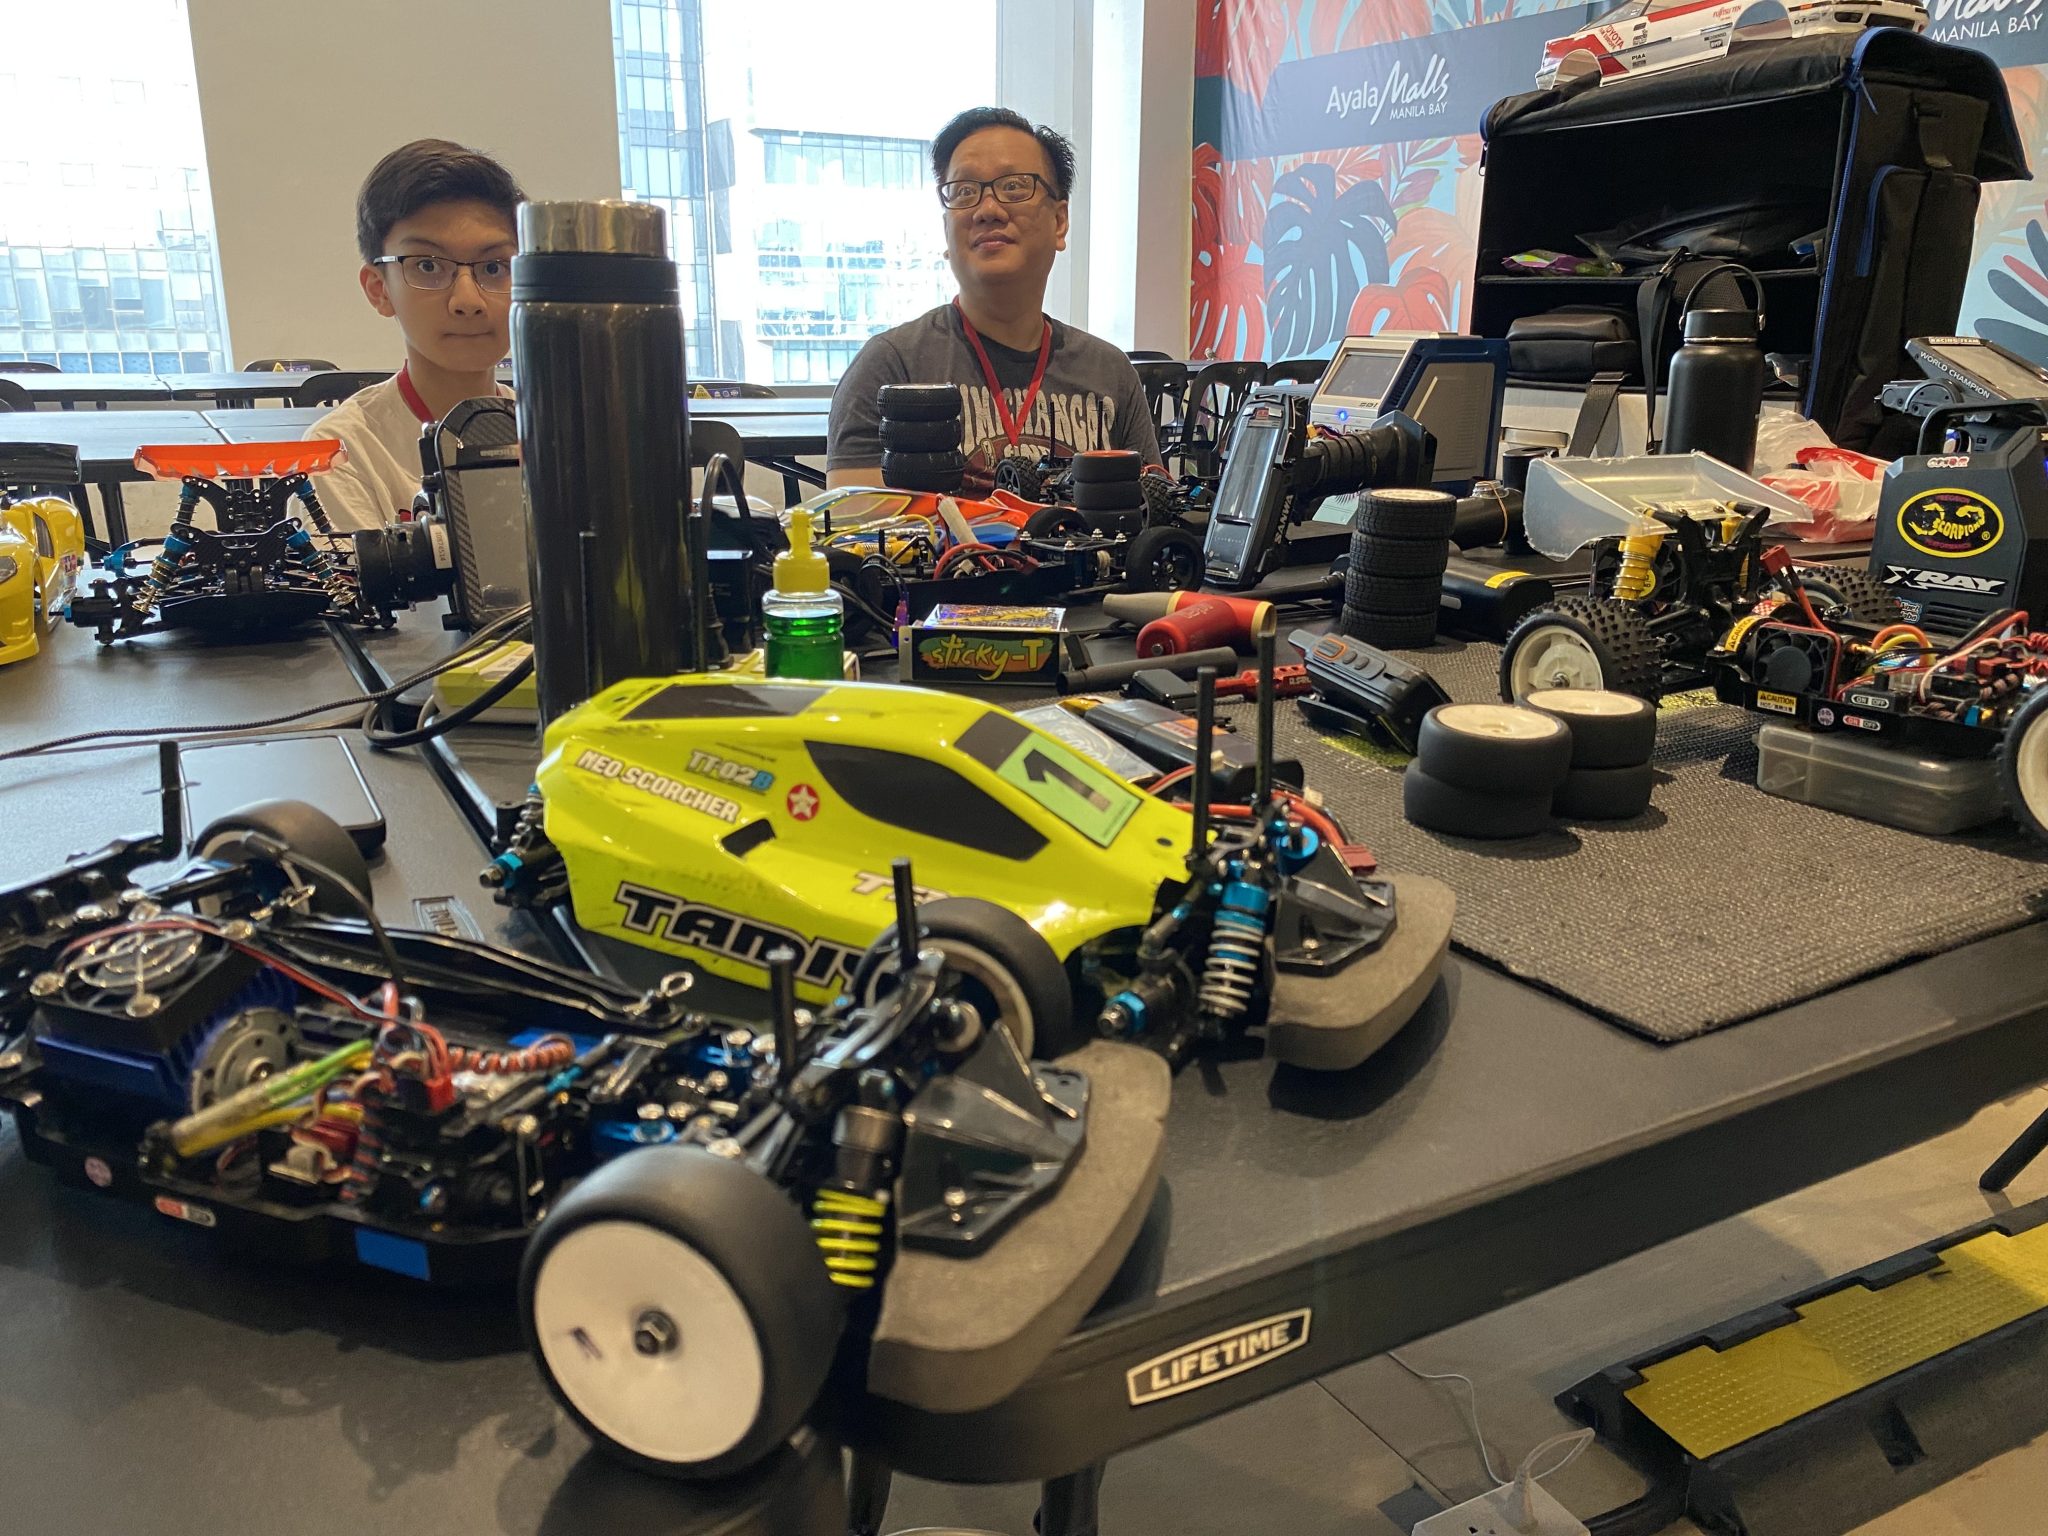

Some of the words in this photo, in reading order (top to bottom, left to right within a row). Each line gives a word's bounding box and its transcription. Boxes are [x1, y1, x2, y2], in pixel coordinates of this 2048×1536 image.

[1931, 19, 2000, 42] MANILA
[2008, 13, 2043, 33] BAY
[1631, 53, 1646, 61] PIAA
[1325, 85, 1379, 119] Ayala
[1370, 53, 1450, 125] Malls
[1390, 105, 1425, 120] MANILA
[1428, 102, 1448, 115] BAY
[1920, 351, 1948, 372] WORLD
[1949, 369, 1991, 399] CHAMPION
[1274, 494, 1294, 546] SANWA
[1767, 694, 1795, 706] CAUTION
[1872, 698, 1887, 706] OFF
[576, 749, 622, 780] NEO
[618, 764, 742, 825] SCORCHER
[1023, 748, 1112, 814] 1
[1151, 1320, 1291, 1391] LIFETIME
